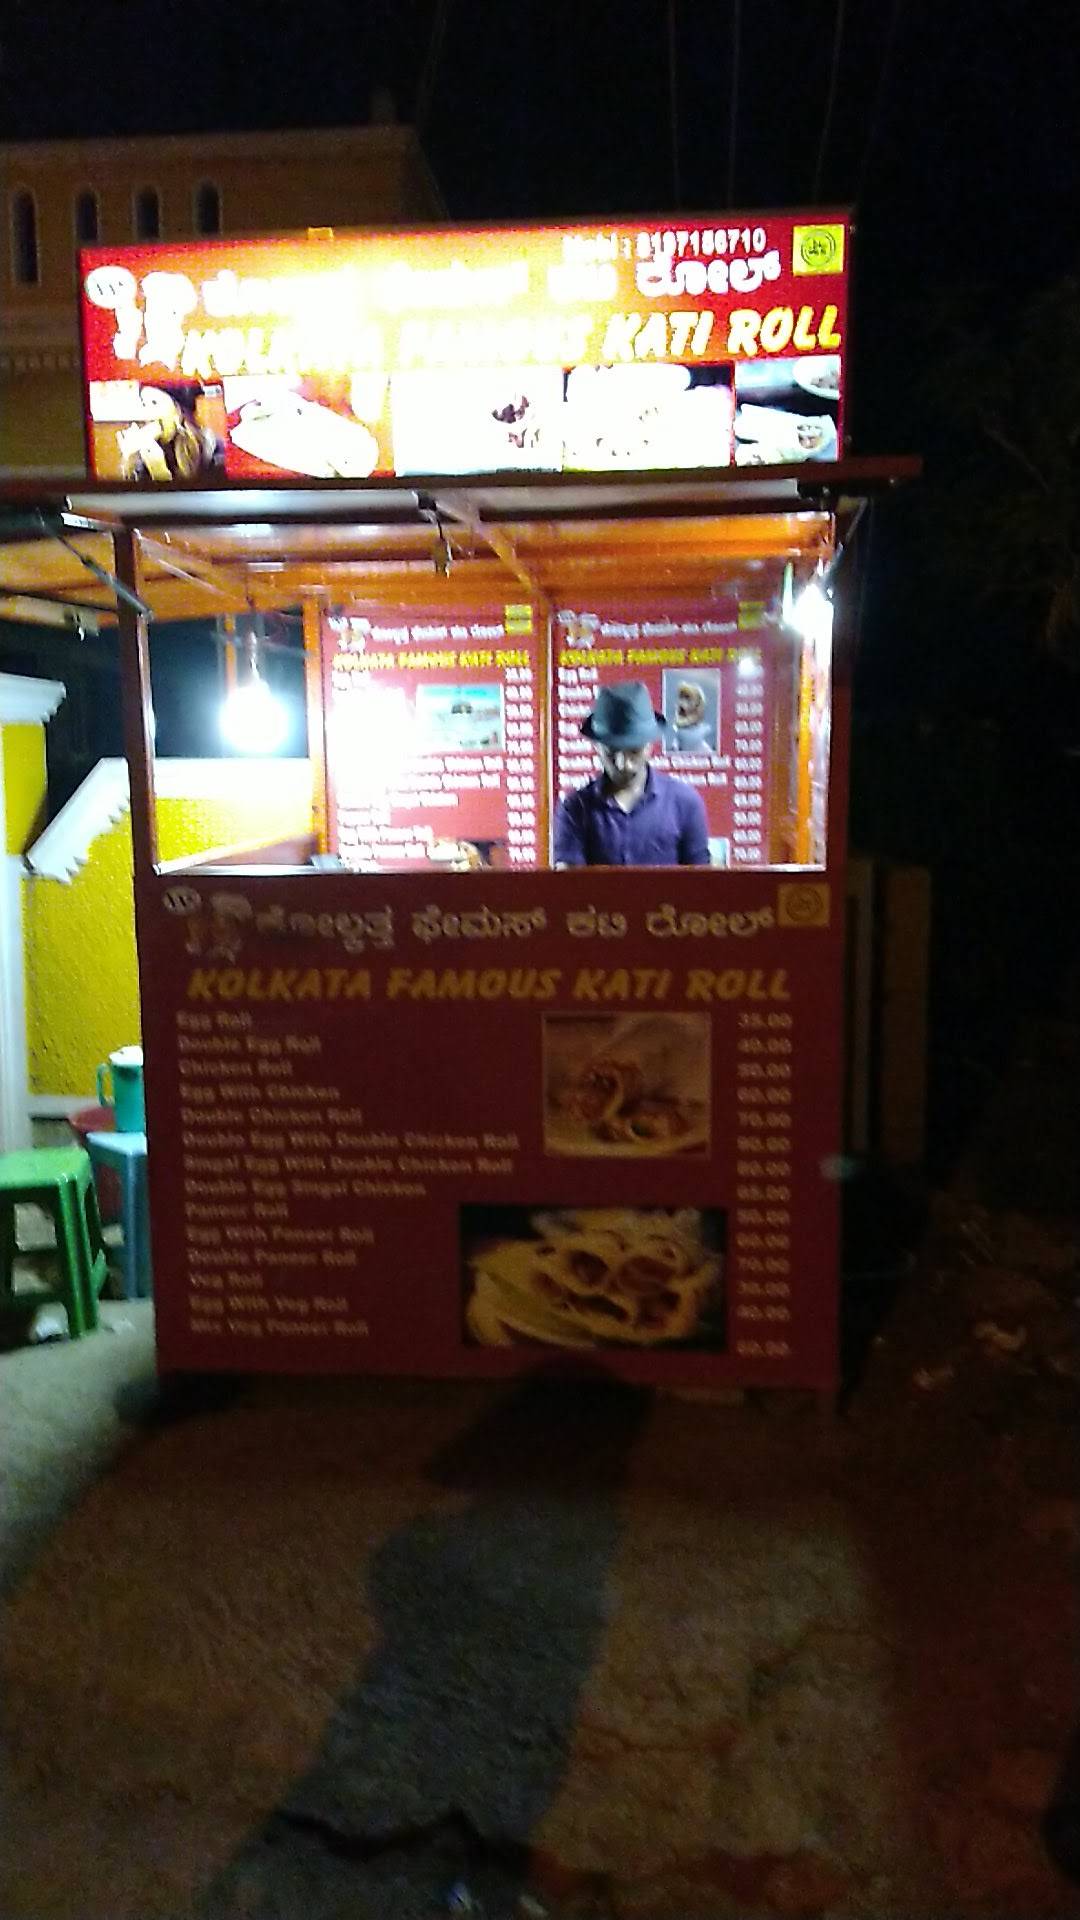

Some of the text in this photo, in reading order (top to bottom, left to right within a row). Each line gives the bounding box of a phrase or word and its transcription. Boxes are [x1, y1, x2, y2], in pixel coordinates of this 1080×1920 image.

[602, 311, 715, 364] KATI
[727, 304, 842, 356] ROLL
[646, 903, 775, 938] ರೋಲ್
[187, 967, 792, 1001] KOLKATA FAMOUS KATI ROLL
[176, 1011, 252, 1032] Egg Roll
[177, 1035, 321, 1055] Double Egg Roll
[178, 1059, 293, 1077] Chicken Roll
[180, 1083, 340, 1103] Egg With Chicken
[181, 1107, 362, 1125] Double Chicken Roll
[737, 1112, 791, 1128] 70.00
[183, 1131, 519, 1151] Double Egg With Double Chicken Roll
[245, 1156, 279, 1175] Egg
[285, 1156, 326, 1172] With
[330, 1156, 392, 1173] Double
[398, 1156, 472, 1173] Chicken
[477, 1157, 513, 1175] Roll
[184, 1179, 246, 1197] Double
[252, 1180, 286, 1199] Egg
[353, 1180, 426, 1197] Chicken
[254, 1203, 288, 1220] Roll
[187, 1226, 220, 1246] Egg
[225, 1227, 267, 1243] With
[339, 1227, 374, 1245] Roll
[188, 1249, 249, 1266] Double
[322, 1250, 357, 1267] Roll
[737, 1256, 791, 1272] 70.00
[189, 1272, 262, 1290] Veg Roll
[189, 1296, 348, 1315] Egg With Veg Roll
[228, 1319, 261, 1338] Veg
[334, 1320, 368, 1336] Roll
